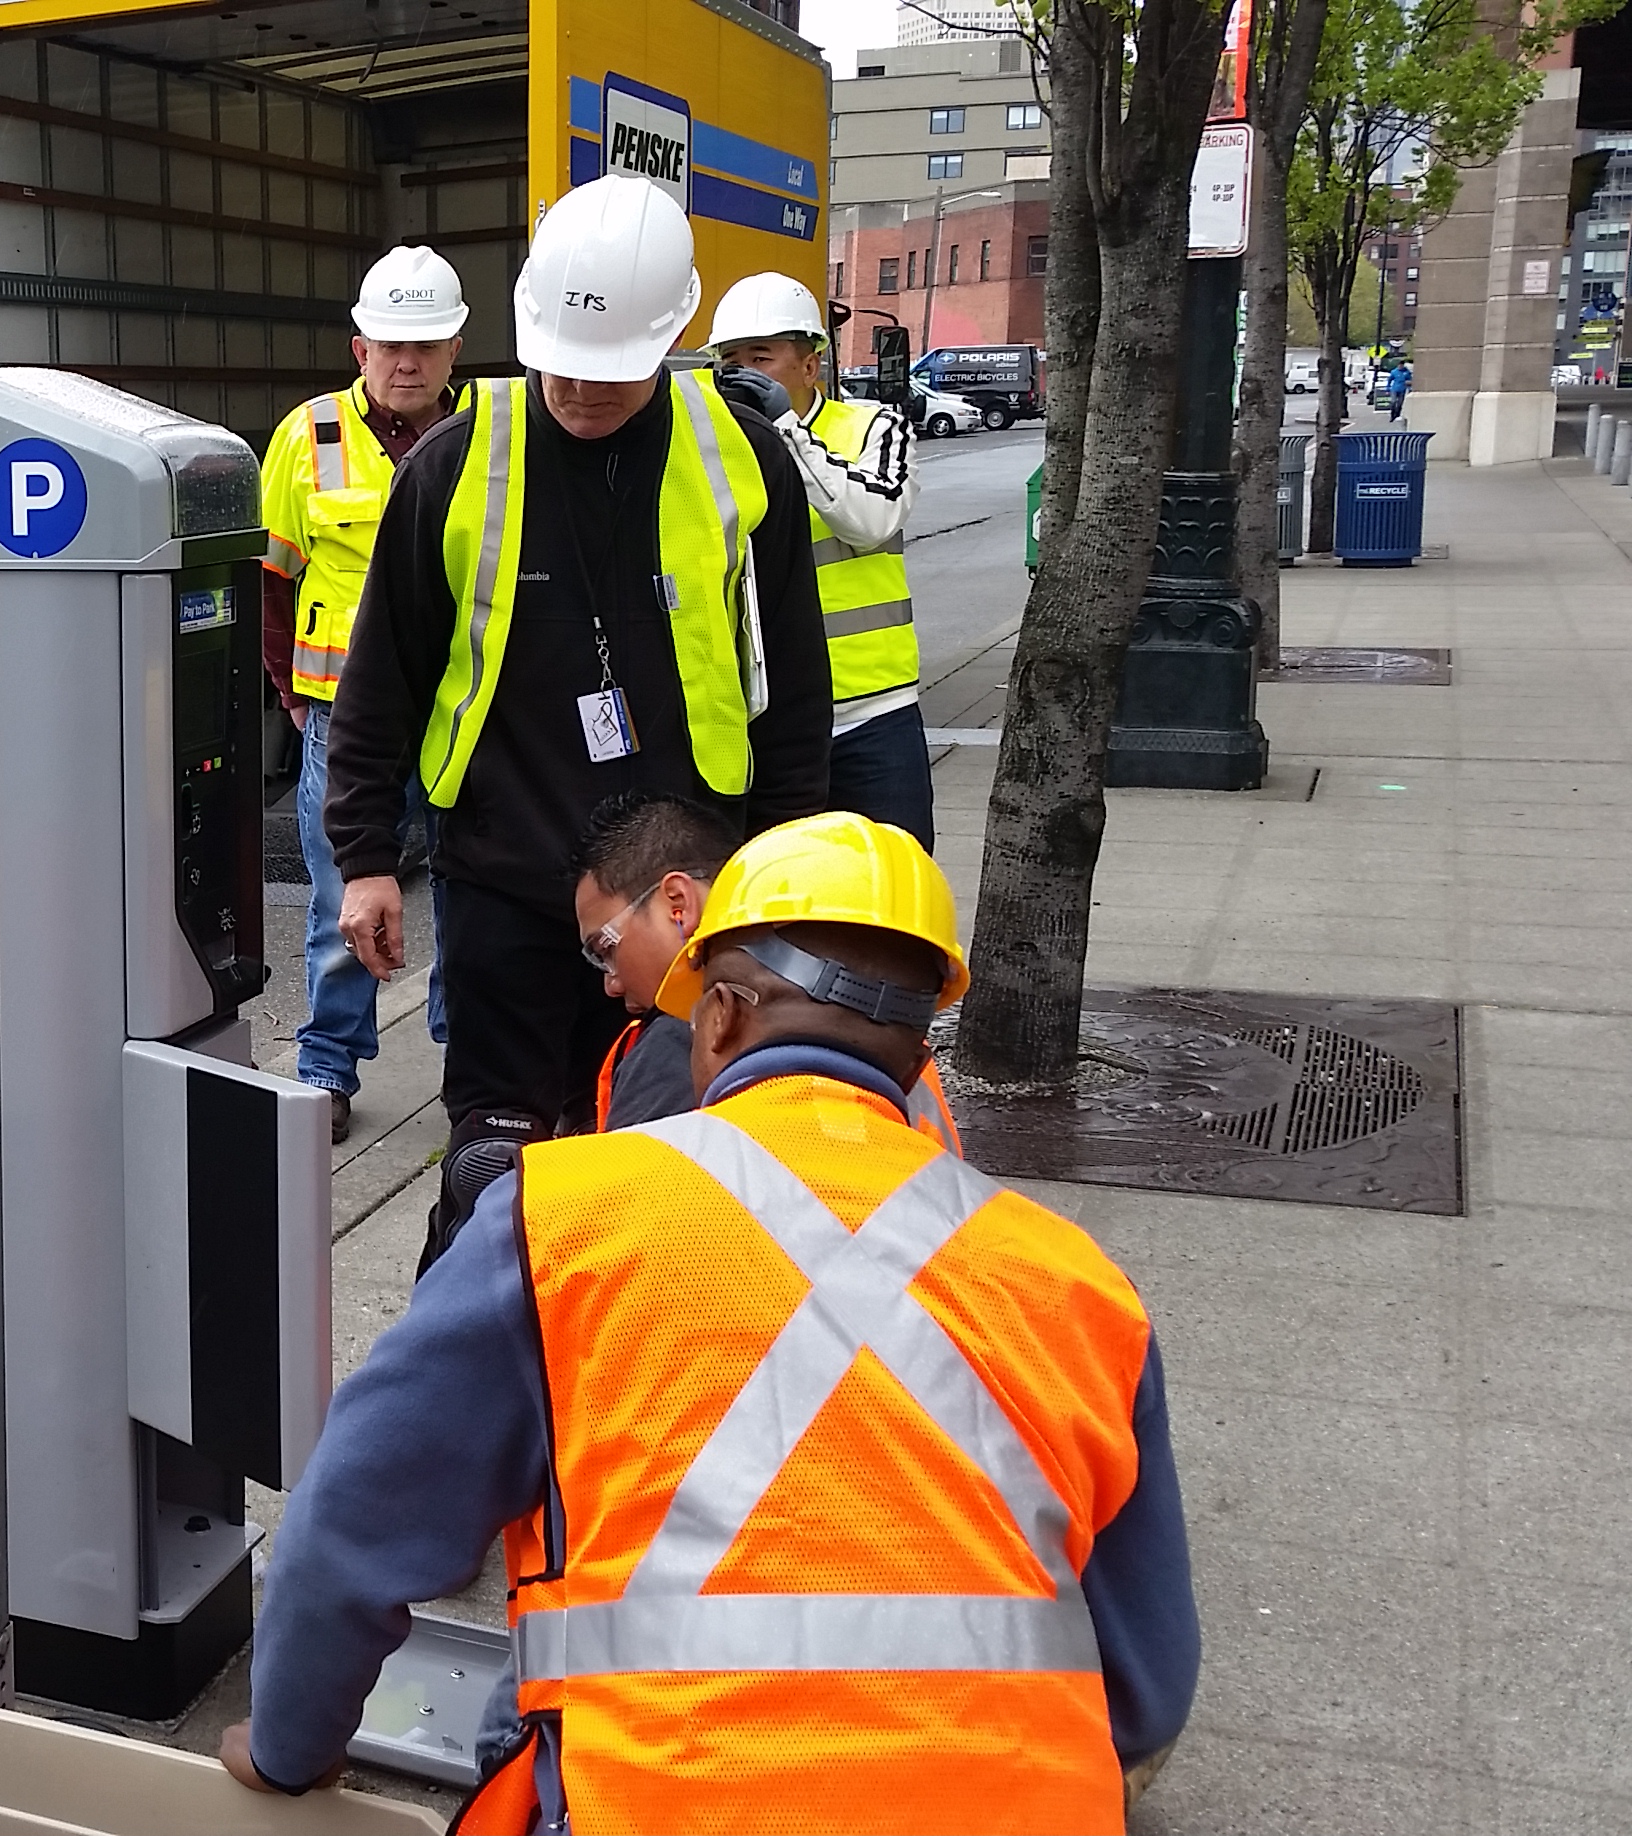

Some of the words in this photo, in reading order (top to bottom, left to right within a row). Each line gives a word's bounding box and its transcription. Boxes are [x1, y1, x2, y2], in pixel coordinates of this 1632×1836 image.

[610, 121, 685, 183] PENSKE
[787, 161, 804, 187] Local
[782, 203, 794, 228] One
[794, 207, 807, 237] Way
[405, 289, 435, 299] SDOT
[565, 291, 607, 312] IPS
[959, 353, 1022, 363] POLARIS
[935, 374, 976, 382] ELECTRIC
[977, 373, 1019, 382] BICYCLES
[11, 461, 64, 536] P
[518, 570, 550, 581] lumbia
[183, 605, 194, 619] Pay
[195, 604, 202, 616] to
[202, 602, 216, 615] Park
[498, 1118, 532, 1130] HUSKY
